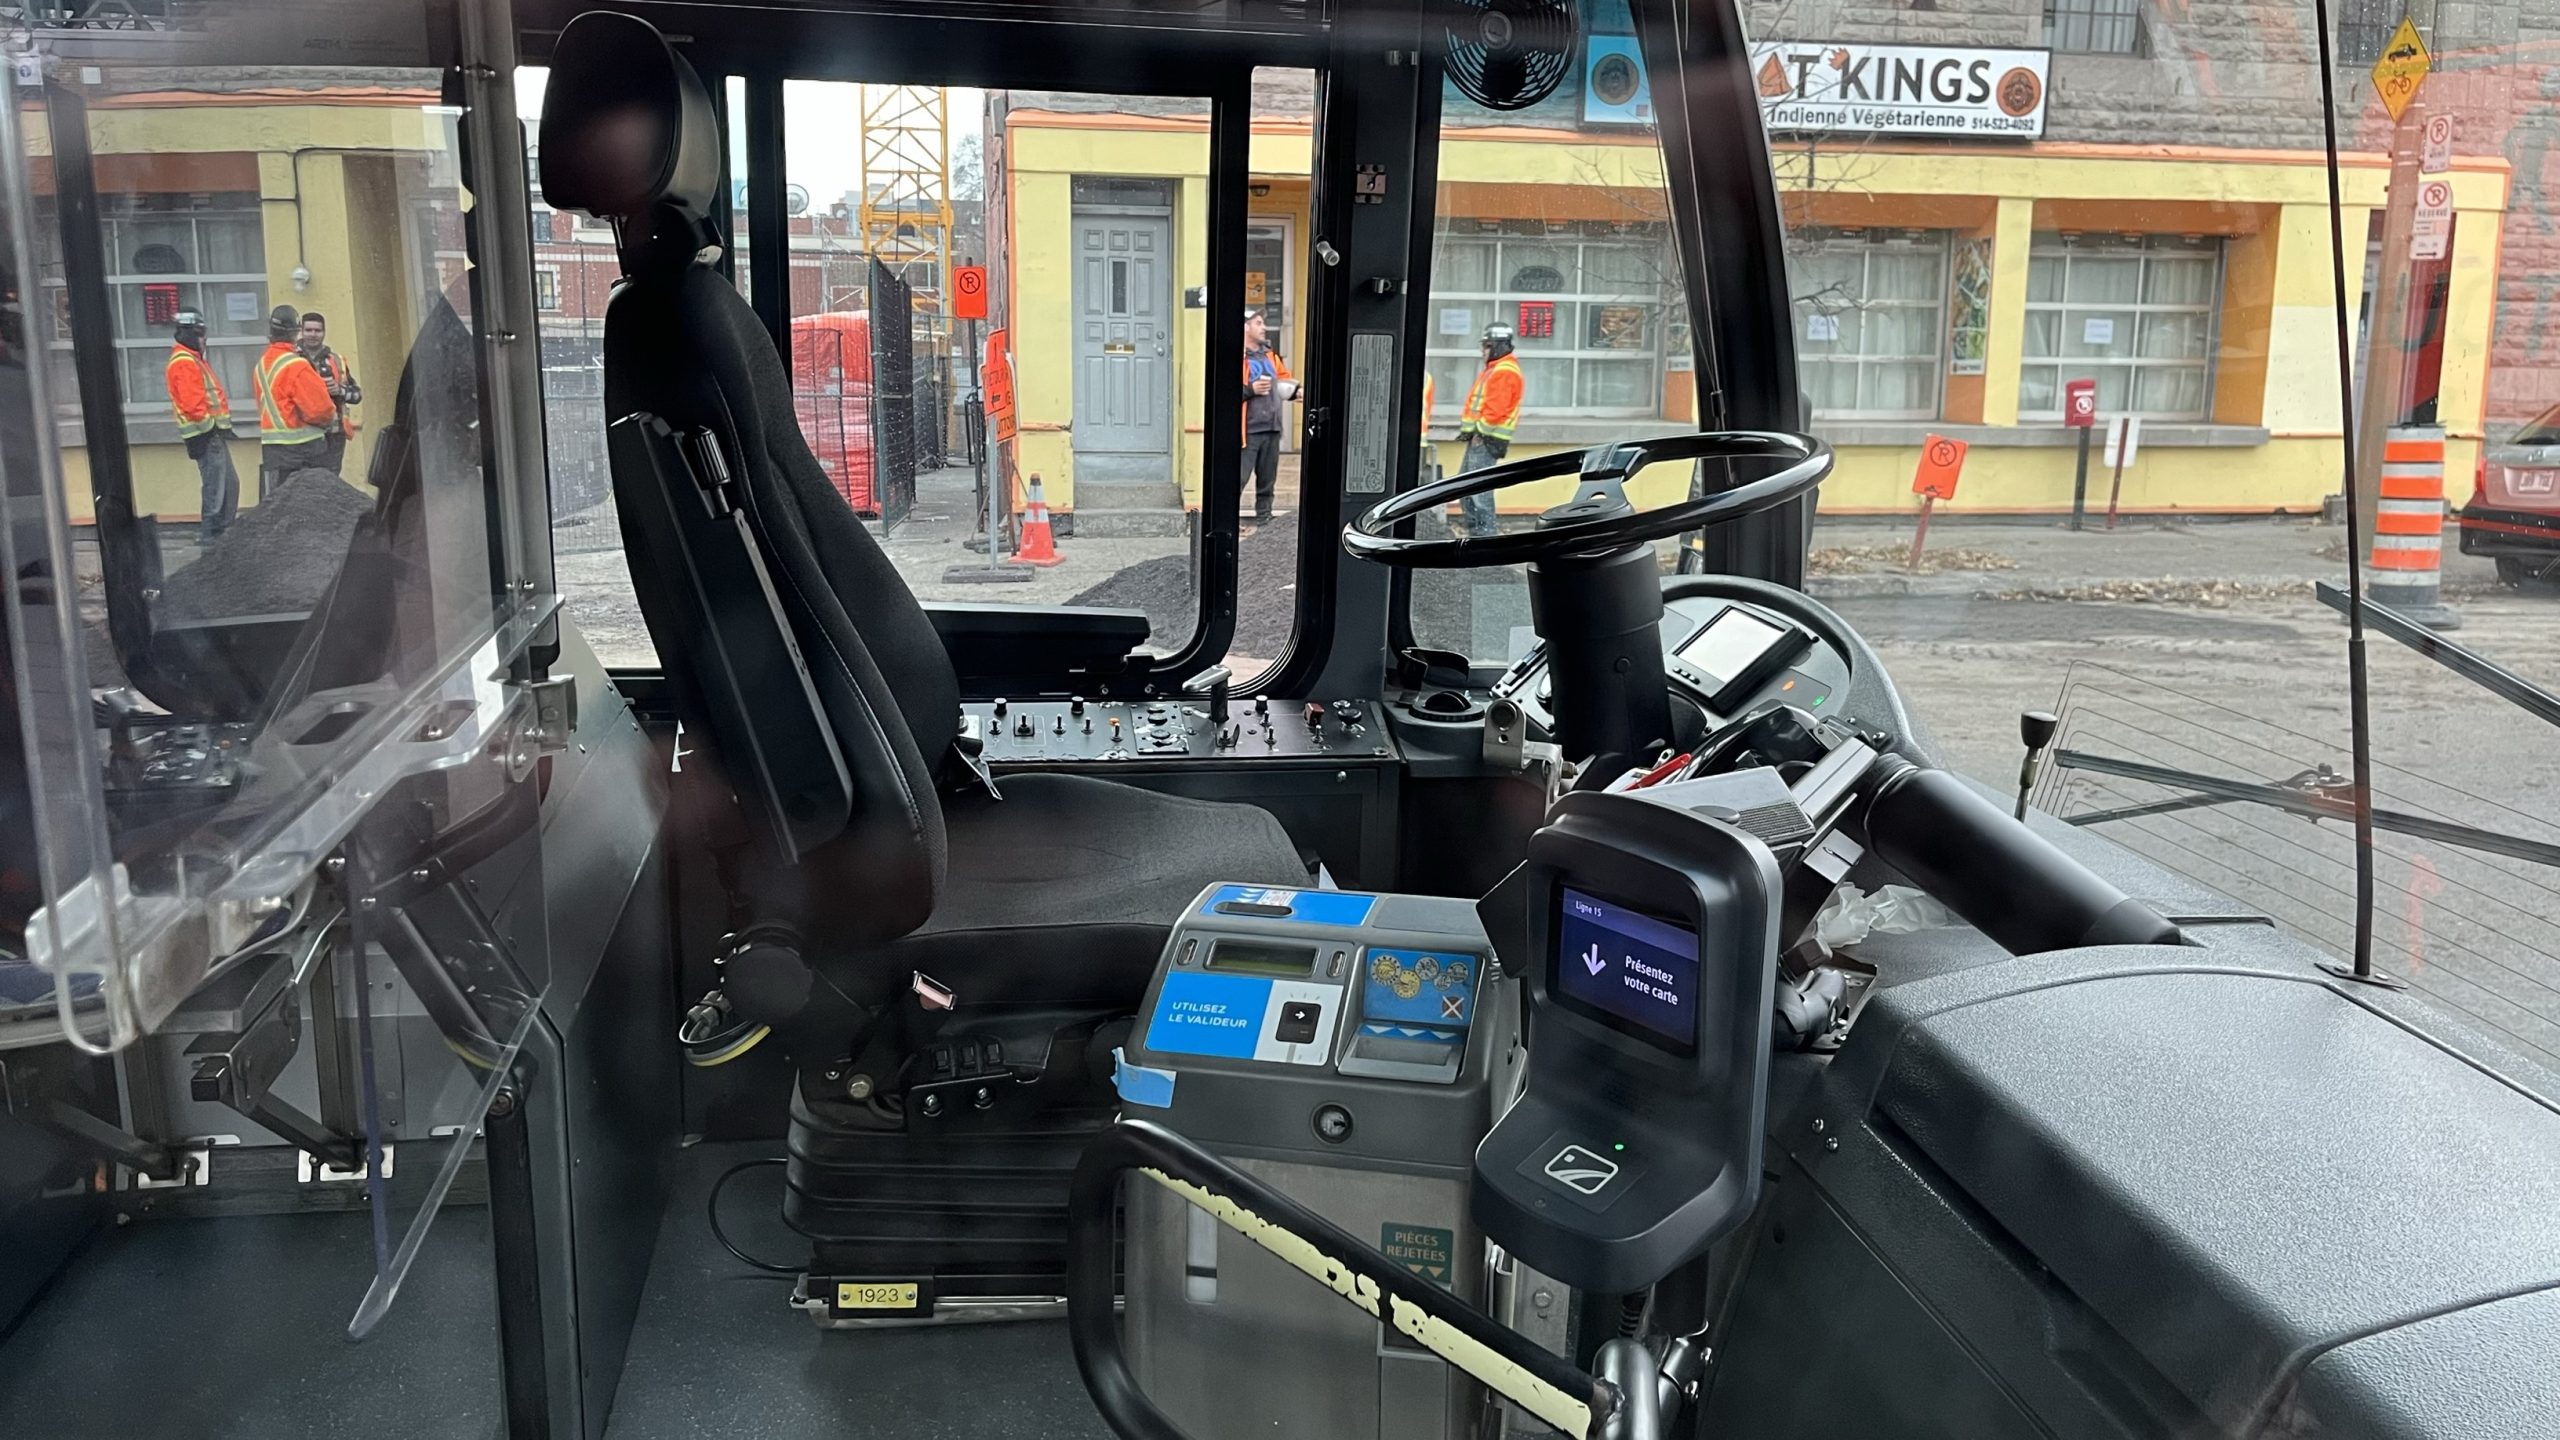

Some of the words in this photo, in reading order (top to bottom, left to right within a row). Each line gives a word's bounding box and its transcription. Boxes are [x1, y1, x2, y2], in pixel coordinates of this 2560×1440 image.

[1838, 56, 1991, 104] KINGS
[1769, 107, 1847, 125] Indienne
[1852, 108, 1966, 129] Végétarienne
[1575, 900, 1593, 914] Ligne
[1593, 906, 1602, 917] 15
[1625, 955, 1674, 985] Présentez
[1623, 974, 1650, 994] votre
[1651, 985, 1679, 1006] carte
[1172, 1001, 1227, 1014] UTILISEZ
[1168, 1013, 1184, 1023] LE
[1187, 1015, 1248, 1029] VALIDEUR
[1386, 1245, 1446, 1262] REJETÉES
[857, 1288, 899, 1303] 1923
